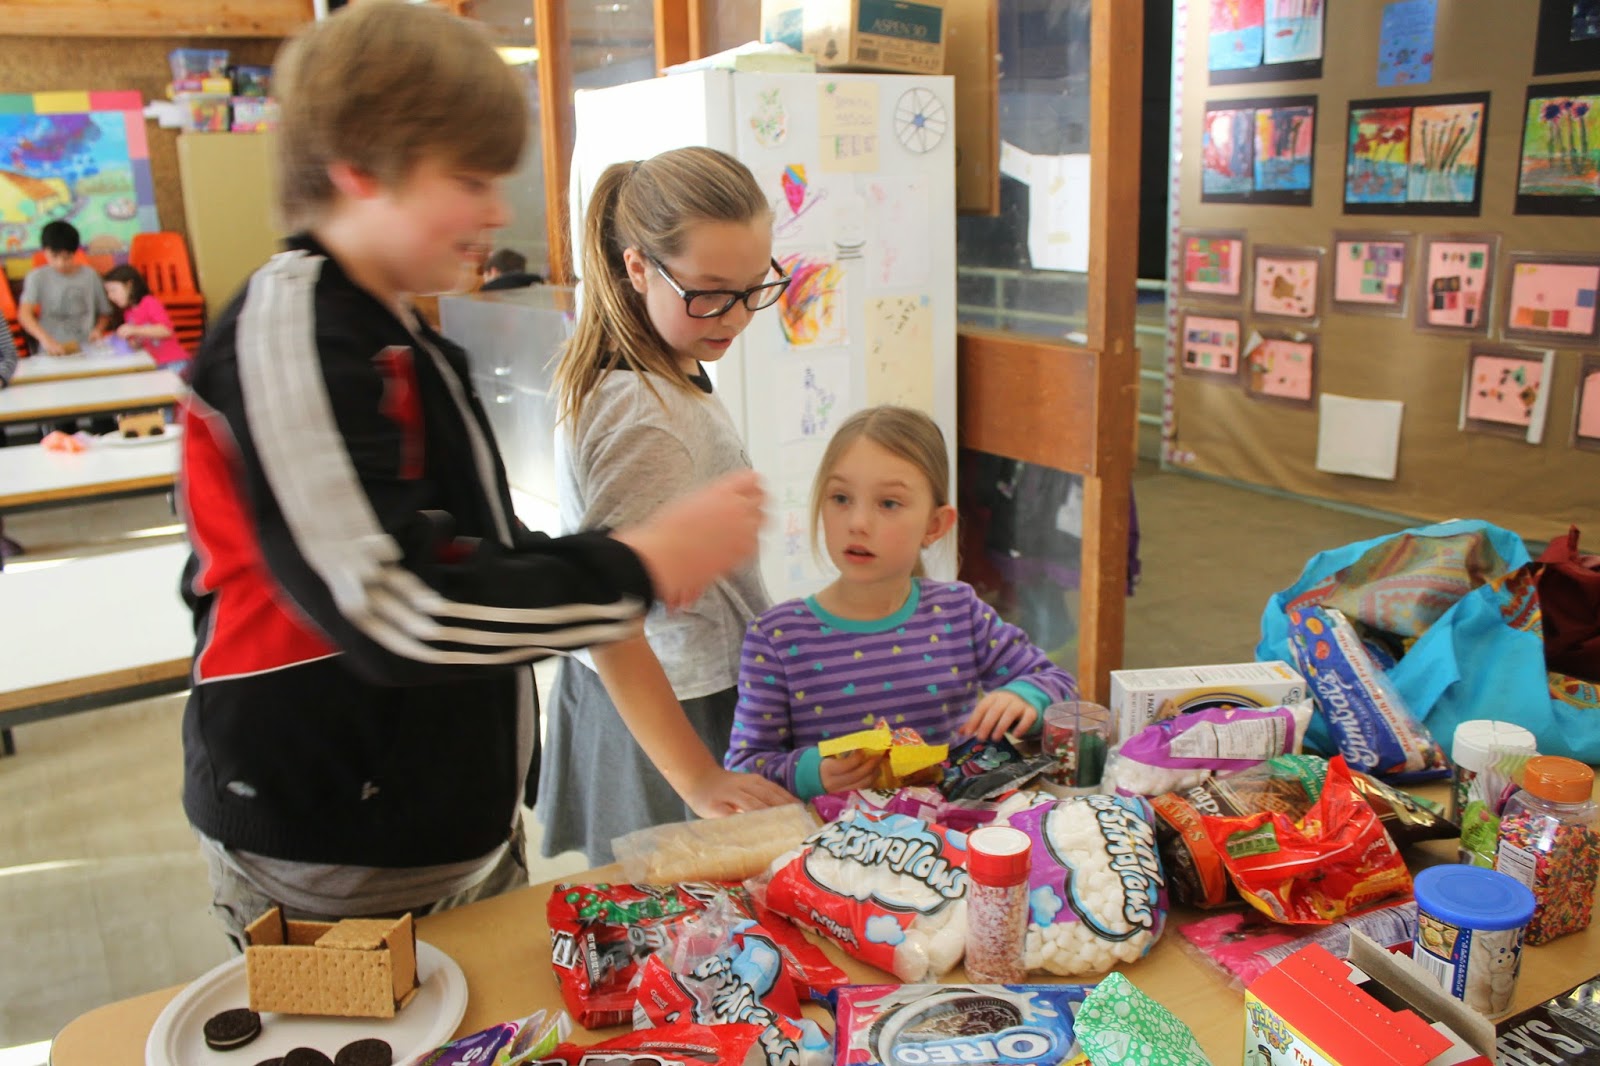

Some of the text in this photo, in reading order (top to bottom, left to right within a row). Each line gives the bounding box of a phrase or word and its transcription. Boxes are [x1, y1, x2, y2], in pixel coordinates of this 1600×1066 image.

[1380, 702, 1397, 724] with
[1246, 1002, 1294, 1045] Tickety
[898, 1034, 1049, 1062] OREO
